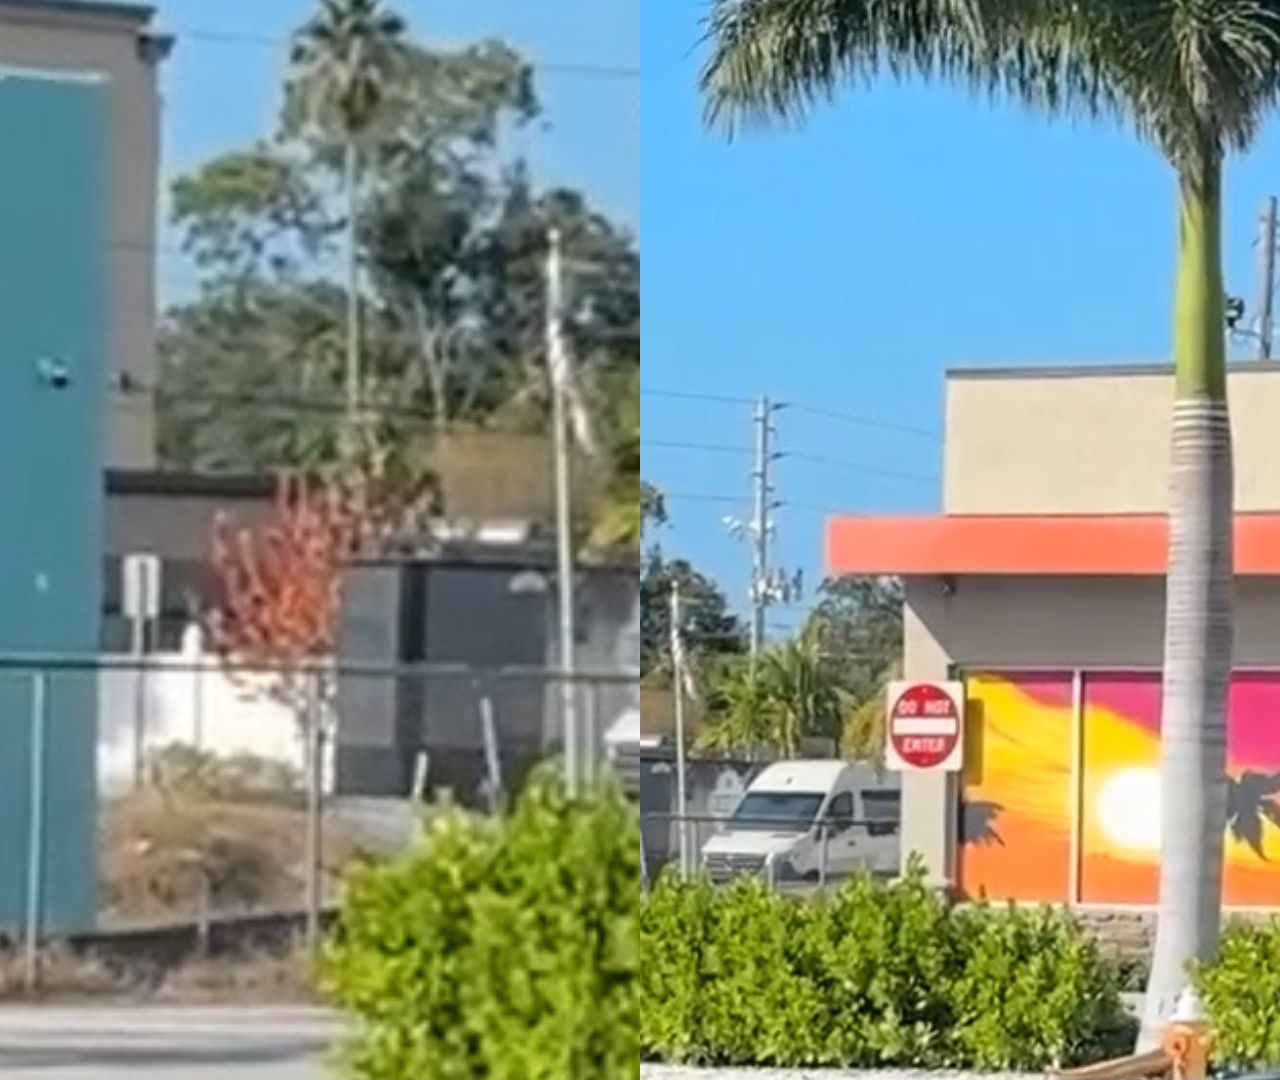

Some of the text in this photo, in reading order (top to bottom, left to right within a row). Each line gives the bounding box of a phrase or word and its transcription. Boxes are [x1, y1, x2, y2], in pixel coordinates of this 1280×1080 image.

[898, 699, 950, 715] DO NOT
[902, 738, 945, 753] ENTER
